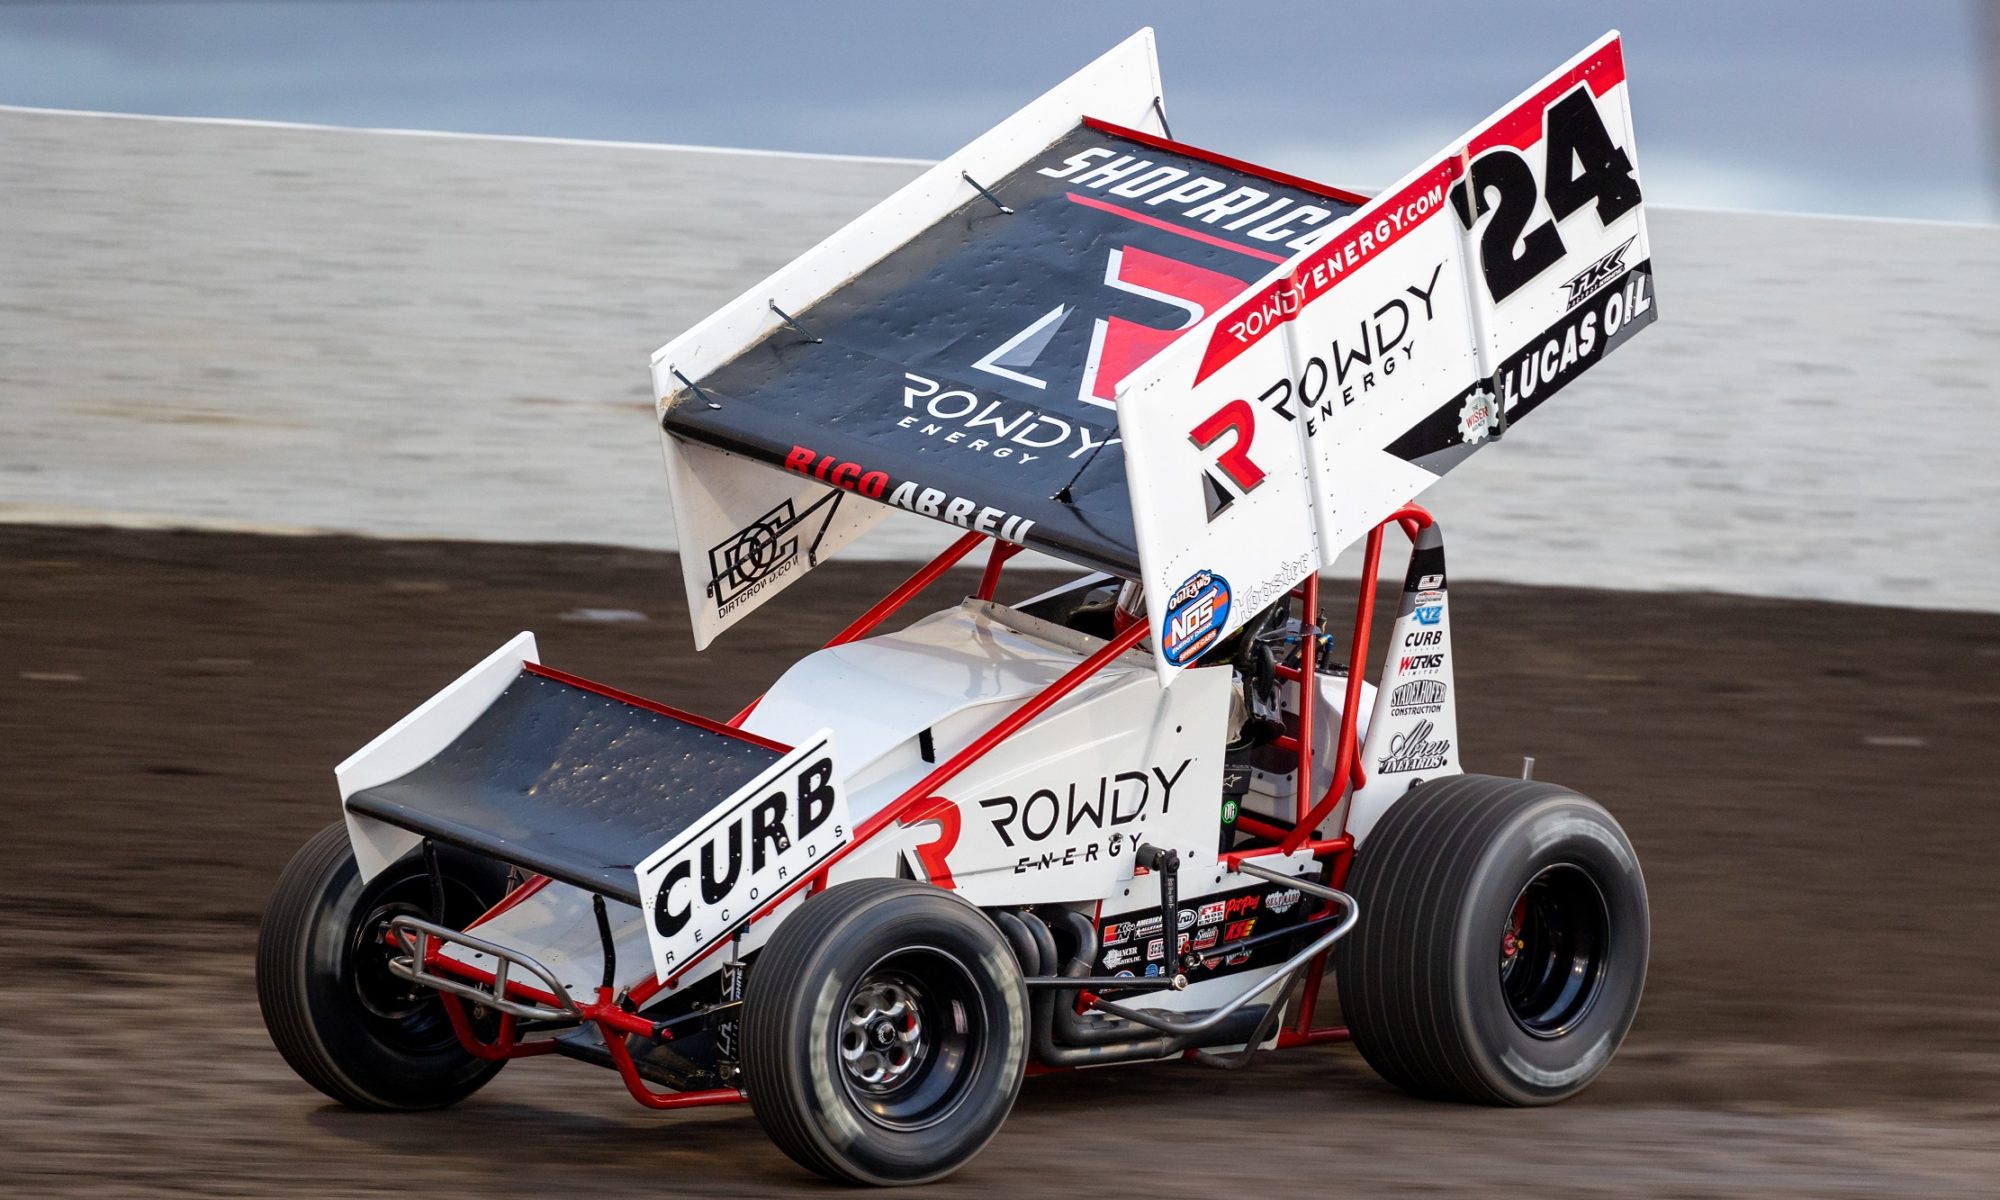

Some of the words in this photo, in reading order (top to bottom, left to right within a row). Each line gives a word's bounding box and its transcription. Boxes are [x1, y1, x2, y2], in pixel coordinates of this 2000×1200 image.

[1450, 86, 1642, 304] 24
[1228, 185, 1443, 342] ROWDYENERGY.COM
[1258, 262, 1443, 421] ROWDY
[1504, 311, 1598, 414] LUCAS
[1604, 274, 1651, 337] OIL
[903, 372, 1123, 459] ROWDY
[1306, 340, 1415, 438] ENERGY
[896, 416, 1042, 466] ENERGY
[784, 445, 890, 499] RICO
[889, 481, 1037, 544] ABREU
[1170, 586, 1219, 648] NOS
[1404, 630, 1443, 648] CURB
[1391, 704, 1442, 717] CONSTRUCTION
[1399, 653, 1444, 676] WORKS
[655, 757, 836, 938] CURB
[979, 758, 1192, 848] ROWDY
[665, 825, 844, 965] RECORDS
[1014, 832, 1143, 874] ENERGY
